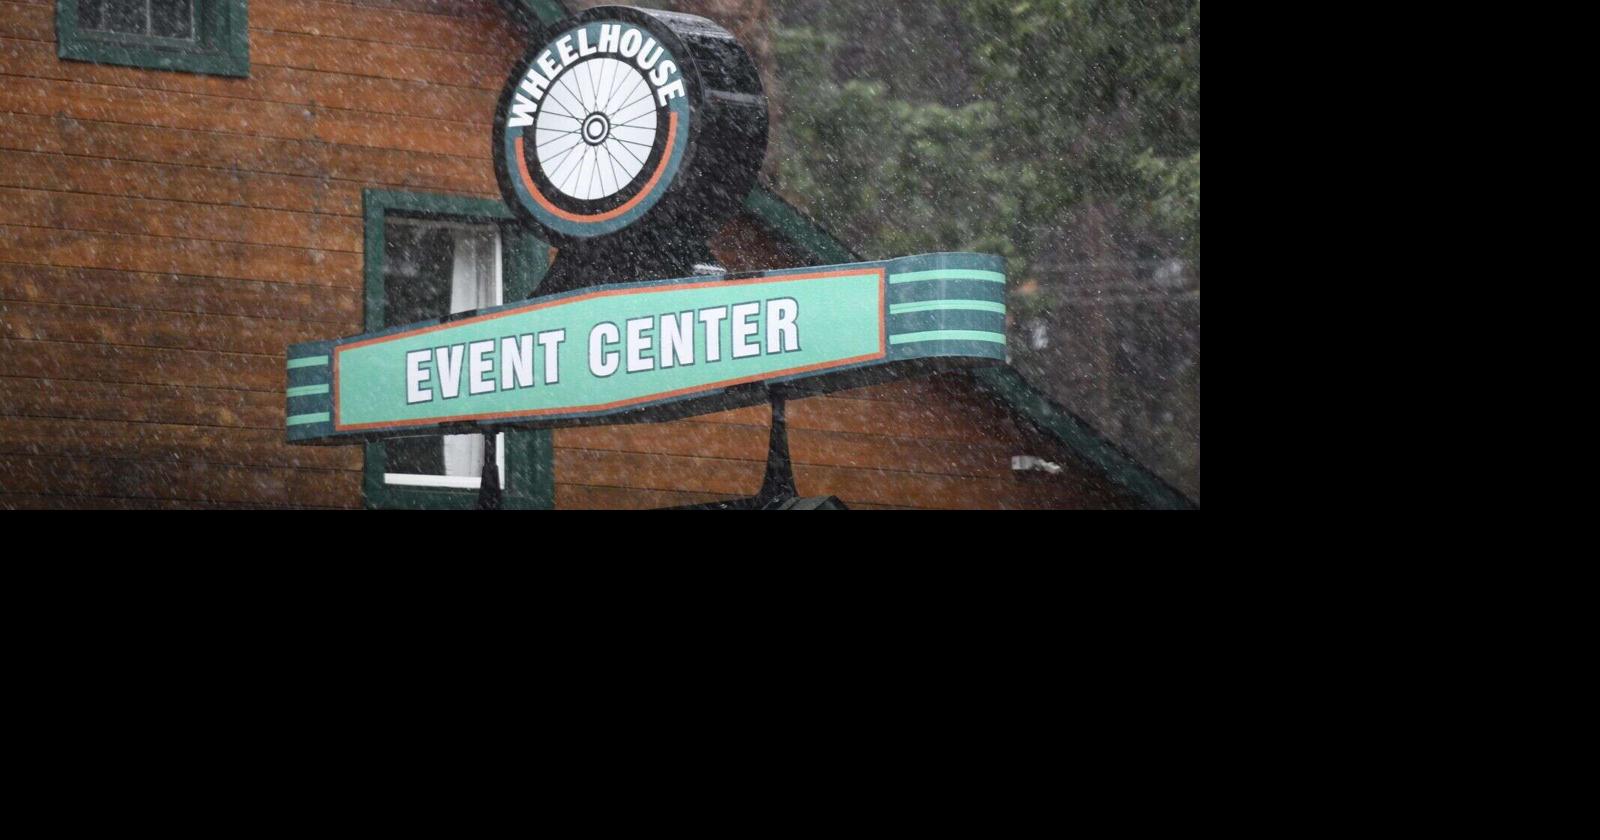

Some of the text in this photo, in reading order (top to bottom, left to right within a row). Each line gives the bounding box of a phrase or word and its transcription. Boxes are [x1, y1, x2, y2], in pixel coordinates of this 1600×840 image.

[508, 24, 685, 127] WHEELHOUSE
[406, 296, 801, 405] EVENT CENTER
